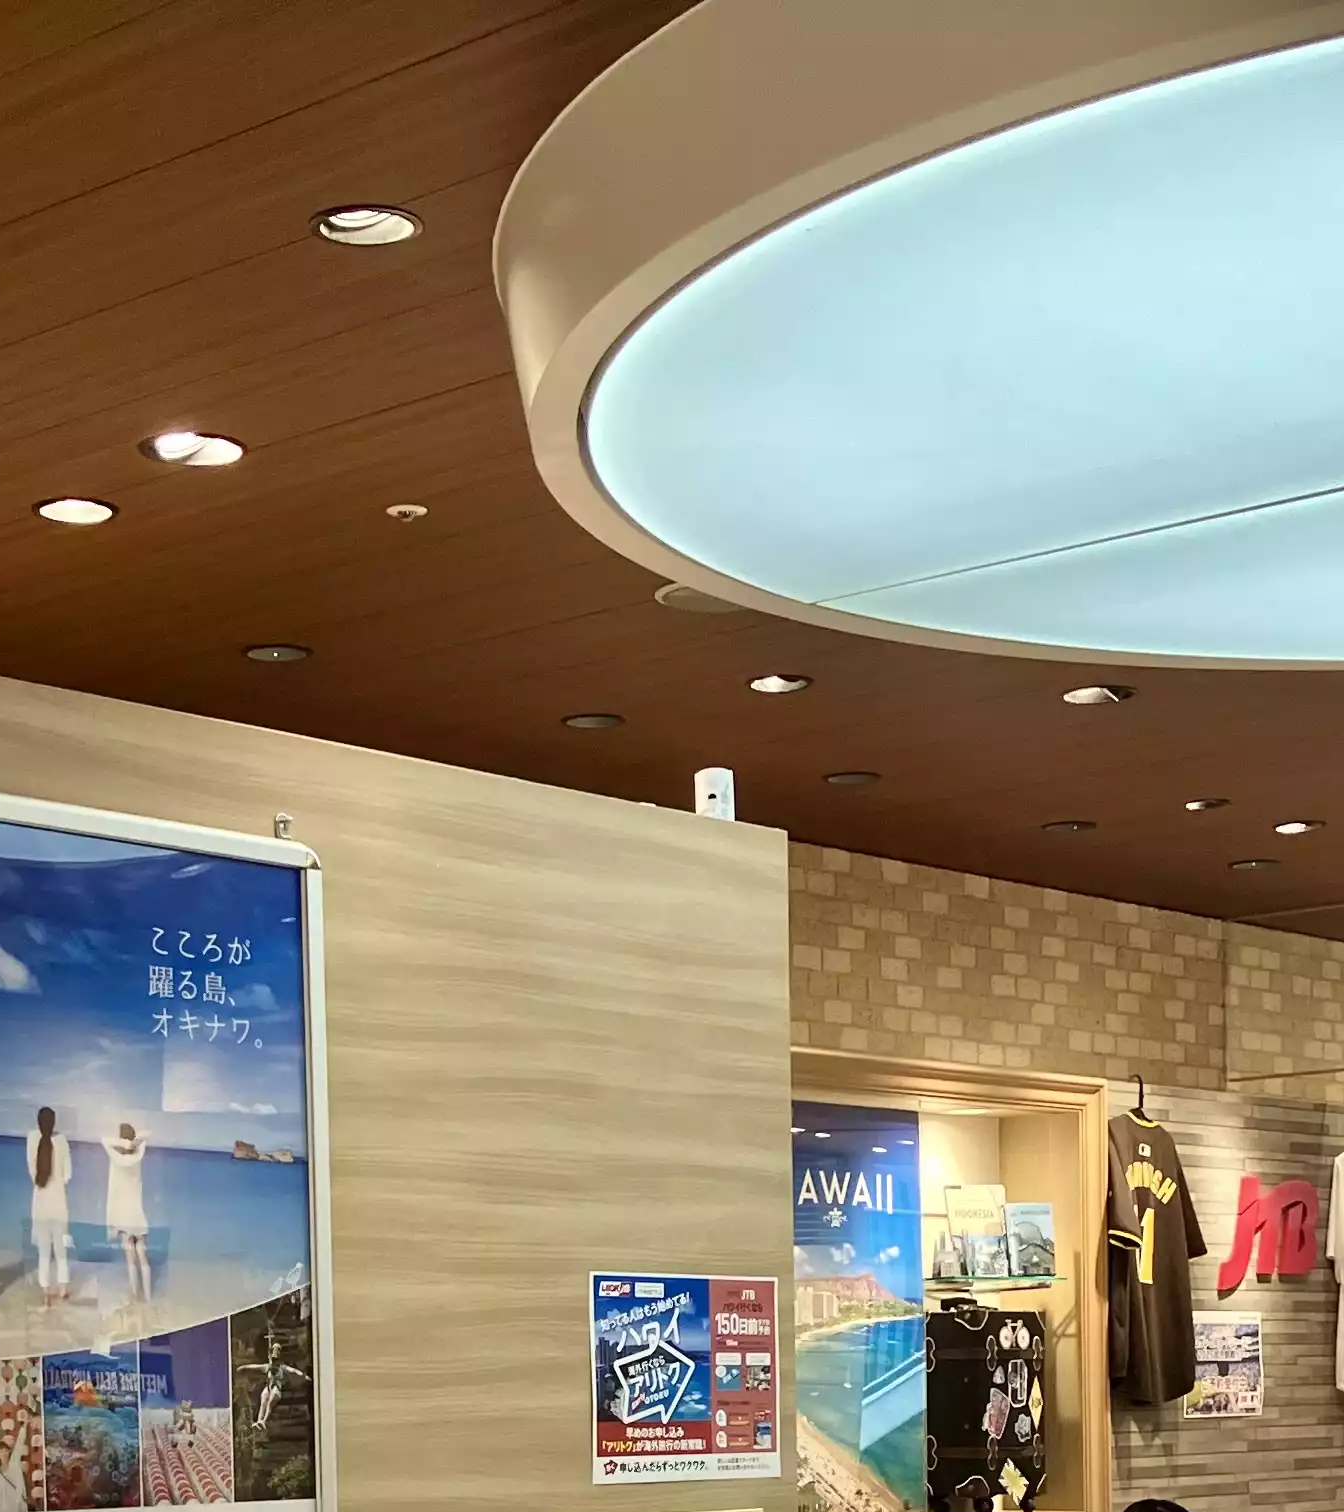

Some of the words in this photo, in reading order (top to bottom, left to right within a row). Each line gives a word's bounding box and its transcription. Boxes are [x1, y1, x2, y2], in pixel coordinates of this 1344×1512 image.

[151, 926, 252, 966] こころが
[148, 964, 237, 1007] 躍る島、
[150, 1007, 264, 1050] オキナワ。
[797, 1170, 895, 1215] AWAII
[1217, 1175, 1320, 1293] JTB
[616, 1306, 681, 1353] ハワイ
[626, 1361, 681, 1398] アリトク
